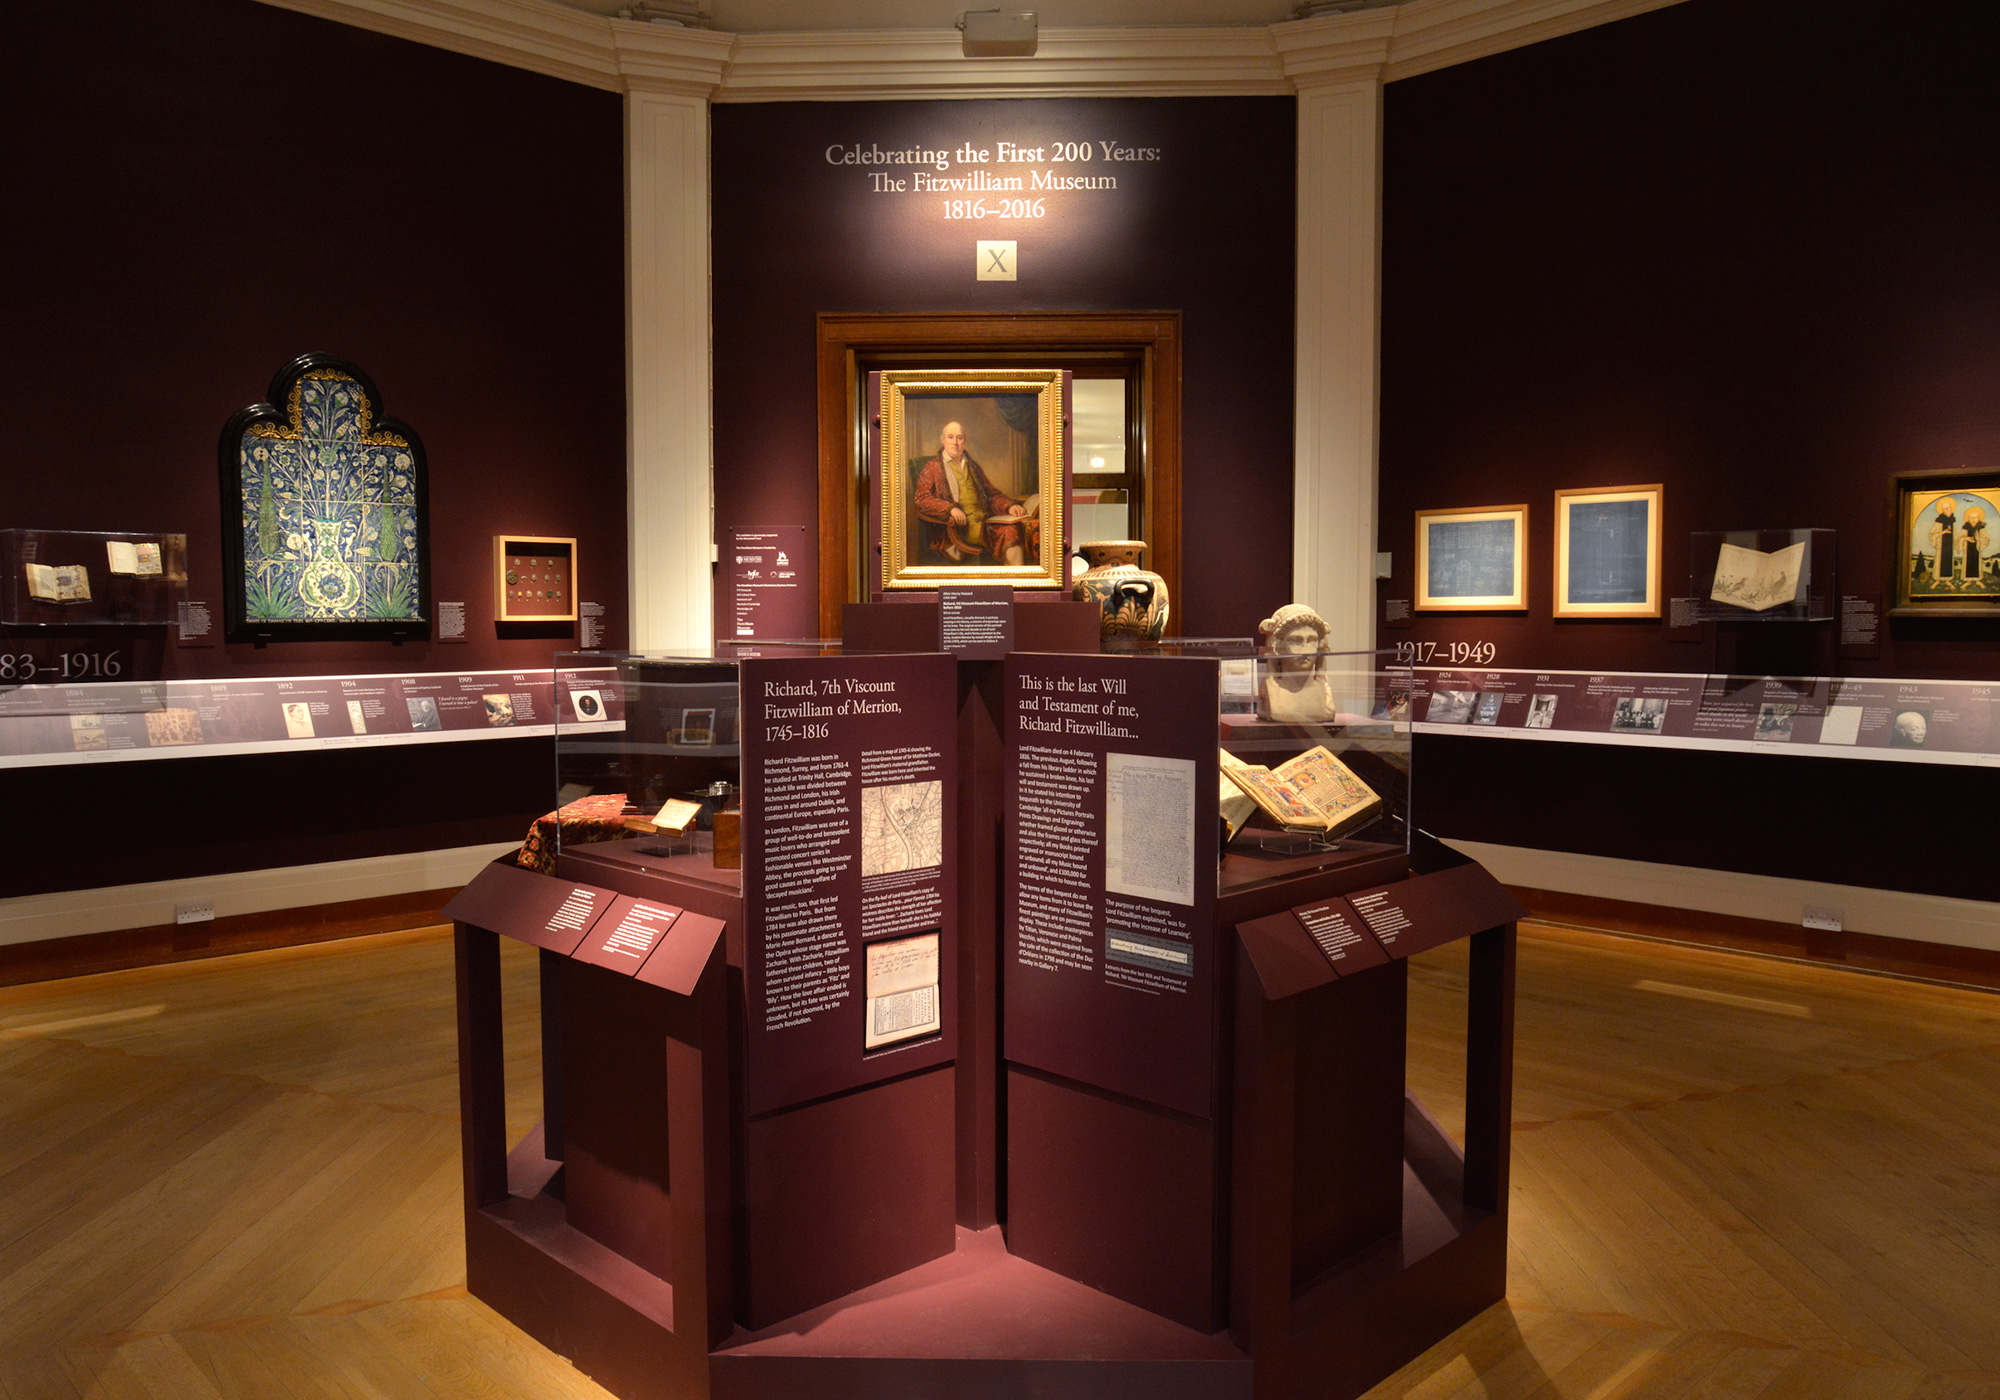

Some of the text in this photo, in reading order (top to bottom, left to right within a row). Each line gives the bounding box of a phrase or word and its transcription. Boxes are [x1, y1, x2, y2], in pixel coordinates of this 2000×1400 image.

[826, 141, 1160, 170] Celebrating the First 200 Years:
[869, 170, 1117, 193] The Fitzwilliam Museum
[943, 198, 1045, 219] 1816–2016
[986, 249, 1008, 273] X
[764, 678, 895, 697] Richard, 7th Viscount
[1019, 675, 1127, 695] This is the last Will
[764, 700, 902, 720] Fitzwilliam of Merrion,
[1019, 697, 1140, 718] and Testament of me,
[765, 723, 829, 742] 1745–1816
[1019, 716, 1061, 732] Richard
[764, 812, 792, 820] continental
[813, 807, 836, 815] especially
[792, 823, 817, 831] Fitzwilliam
[764, 837, 779, 845] group
[813, 830, 822, 838] and
[823, 828, 849, 836] benevolent
[808, 839, 829, 847] arranged
[765, 853, 789, 863] promoted
[790, 851, 809, 859] concert
[765, 862, 793, 871] fashionable
[822, 855, 851, 863] Westminster
[792, 868, 814, 877] proceeds
[765, 882, 778, 891] good
[1105, 907, 1115, 915] Lord
